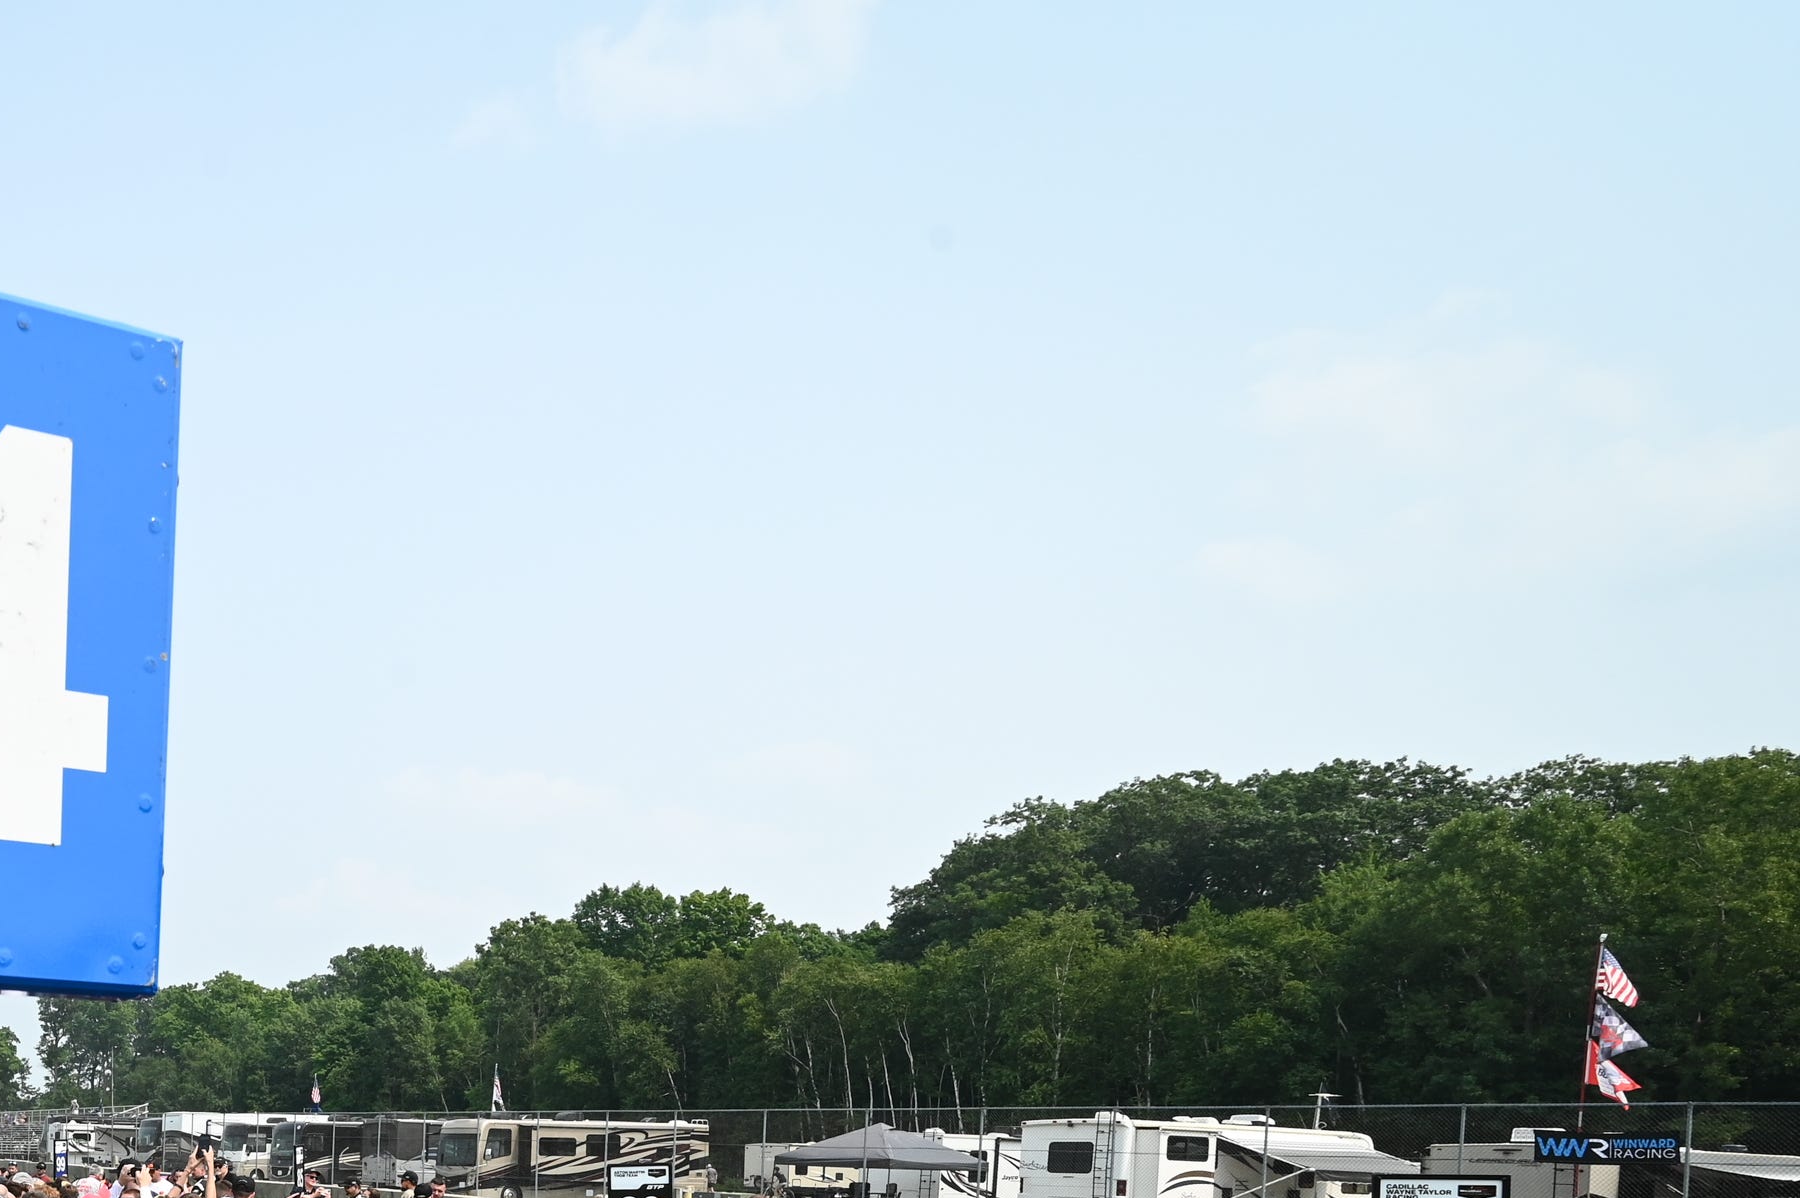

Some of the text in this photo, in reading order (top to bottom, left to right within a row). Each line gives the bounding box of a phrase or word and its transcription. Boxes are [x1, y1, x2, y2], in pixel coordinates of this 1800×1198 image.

[1613, 1138, 1676, 1149] WINWARD
[1613, 1149, 1676, 1159] RACING
[56, 1156, 66, 1172] 99
